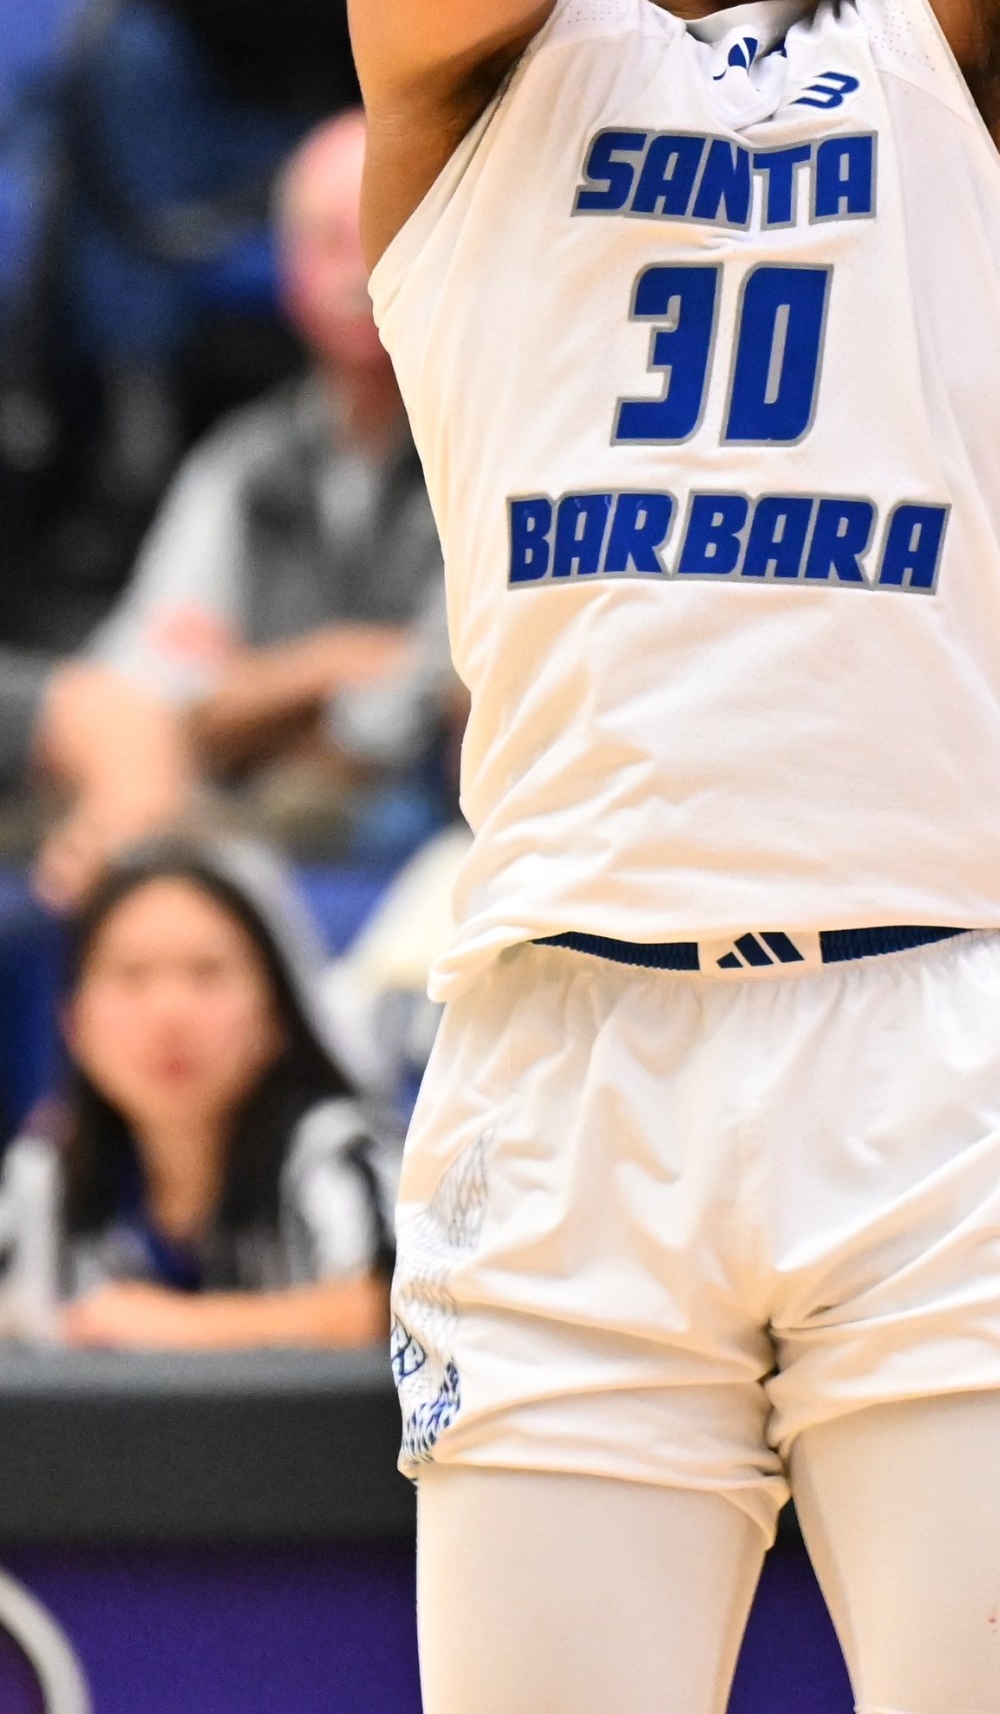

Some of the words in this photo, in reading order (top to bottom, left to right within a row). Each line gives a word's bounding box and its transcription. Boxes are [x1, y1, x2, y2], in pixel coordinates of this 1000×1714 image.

[571, 126, 878, 232] SANTA
[610, 261, 834, 447] 30
[506, 487, 952, 596] BARBARA
